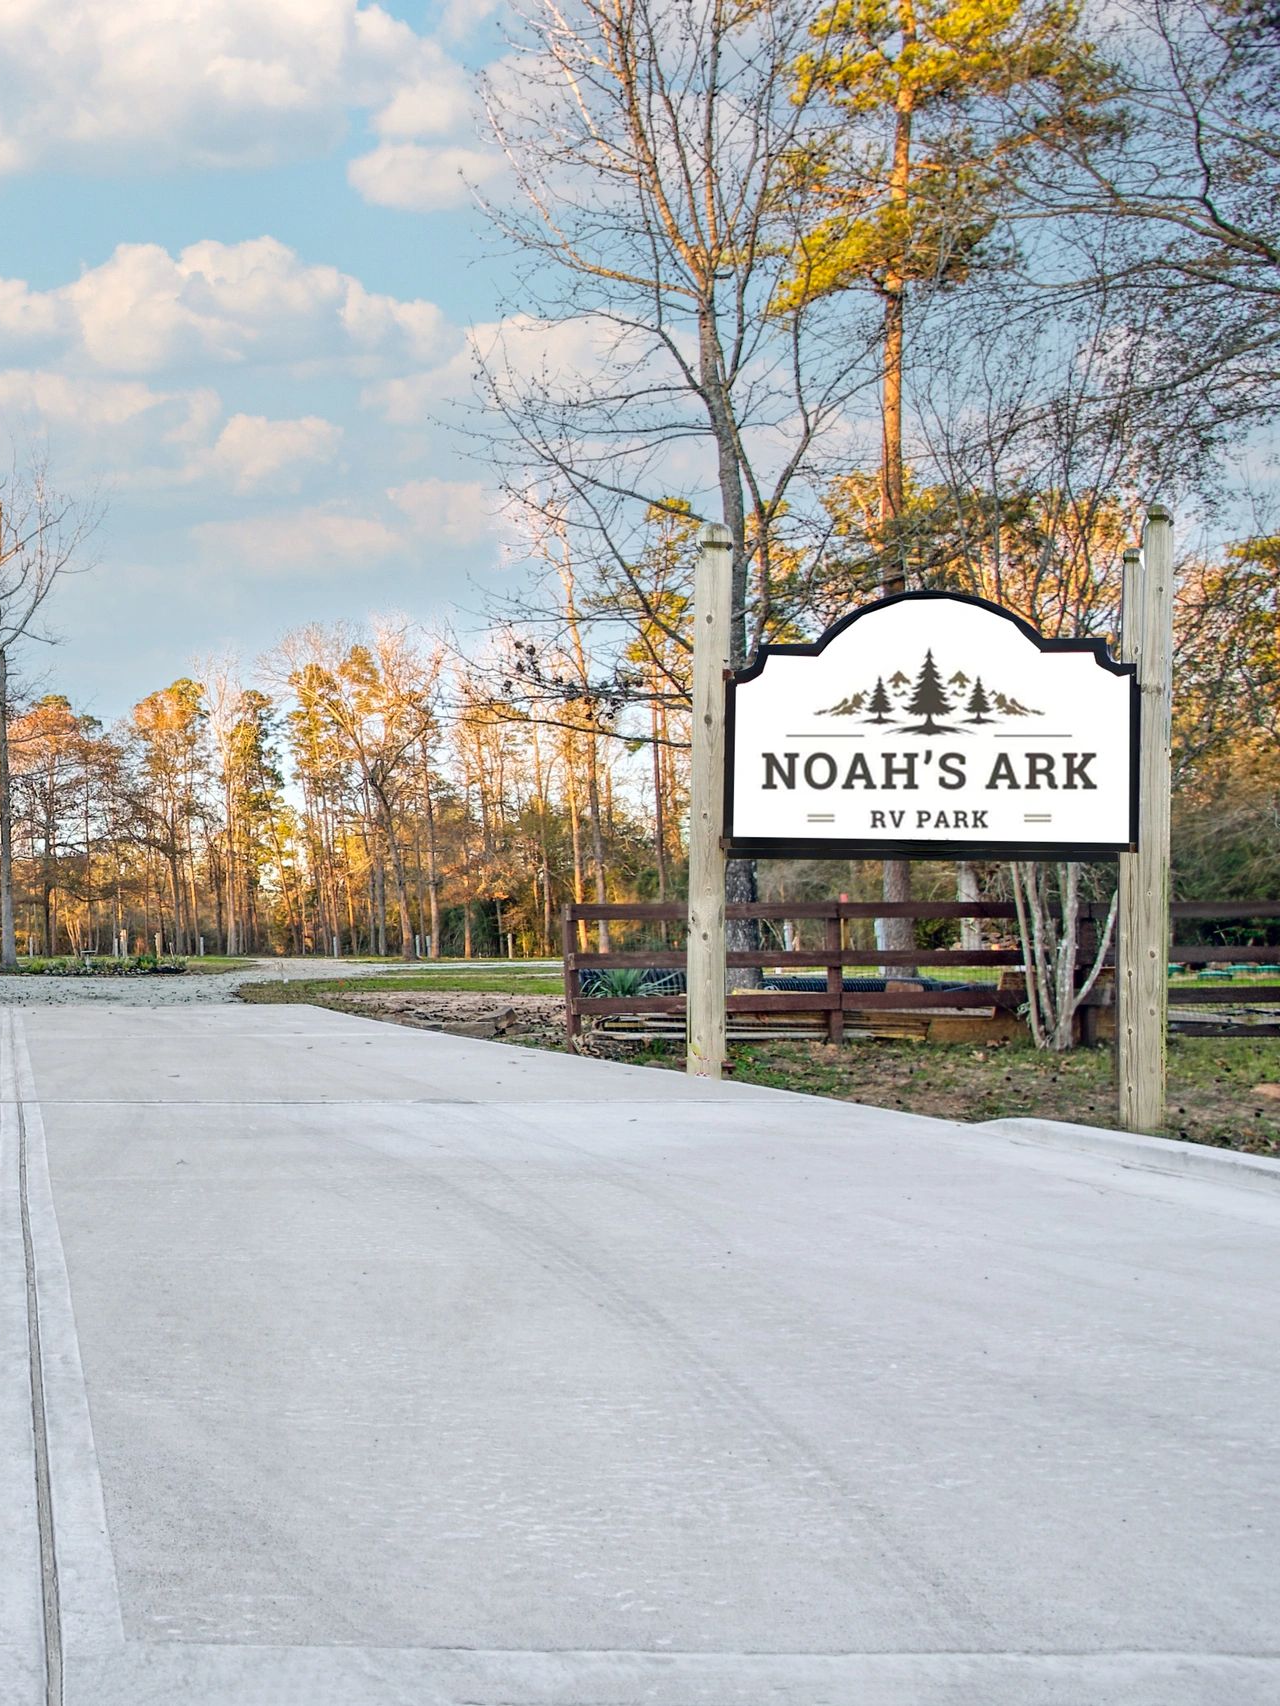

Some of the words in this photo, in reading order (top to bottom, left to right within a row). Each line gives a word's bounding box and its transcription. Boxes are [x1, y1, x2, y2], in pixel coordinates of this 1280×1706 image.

[761, 749, 967, 791] NOAH'S
[984, 752, 1098, 791] ARK
[869, 810, 906, 829] RV
[915, 810, 989, 829] PARK
